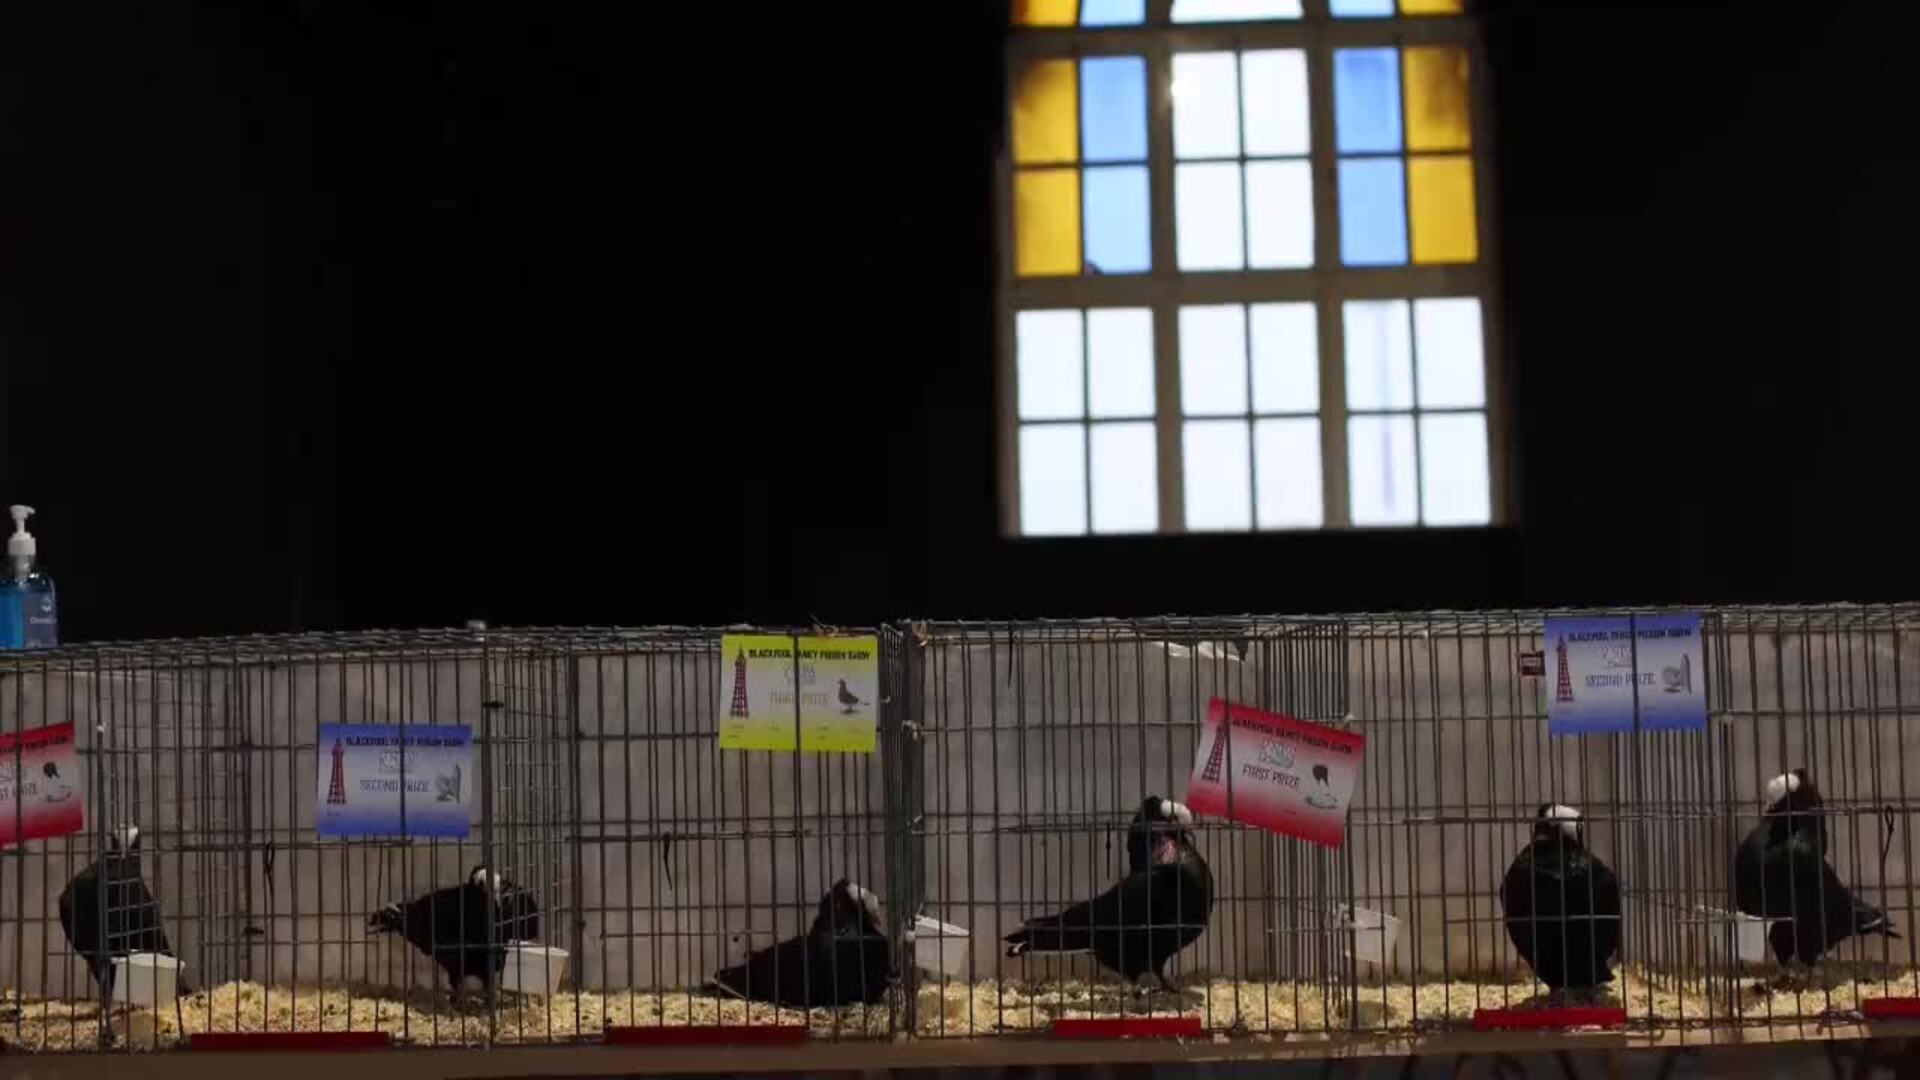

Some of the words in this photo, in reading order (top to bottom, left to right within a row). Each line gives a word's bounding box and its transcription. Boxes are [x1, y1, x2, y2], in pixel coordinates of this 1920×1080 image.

[1585, 673, 1622, 688] SECOND
[1625, 671, 1656, 686] PIZE
[1242, 763, 1269, 781] FIRST
[1271, 771, 1300, 788] PRIZE
[360, 779, 398, 793] SECOND
